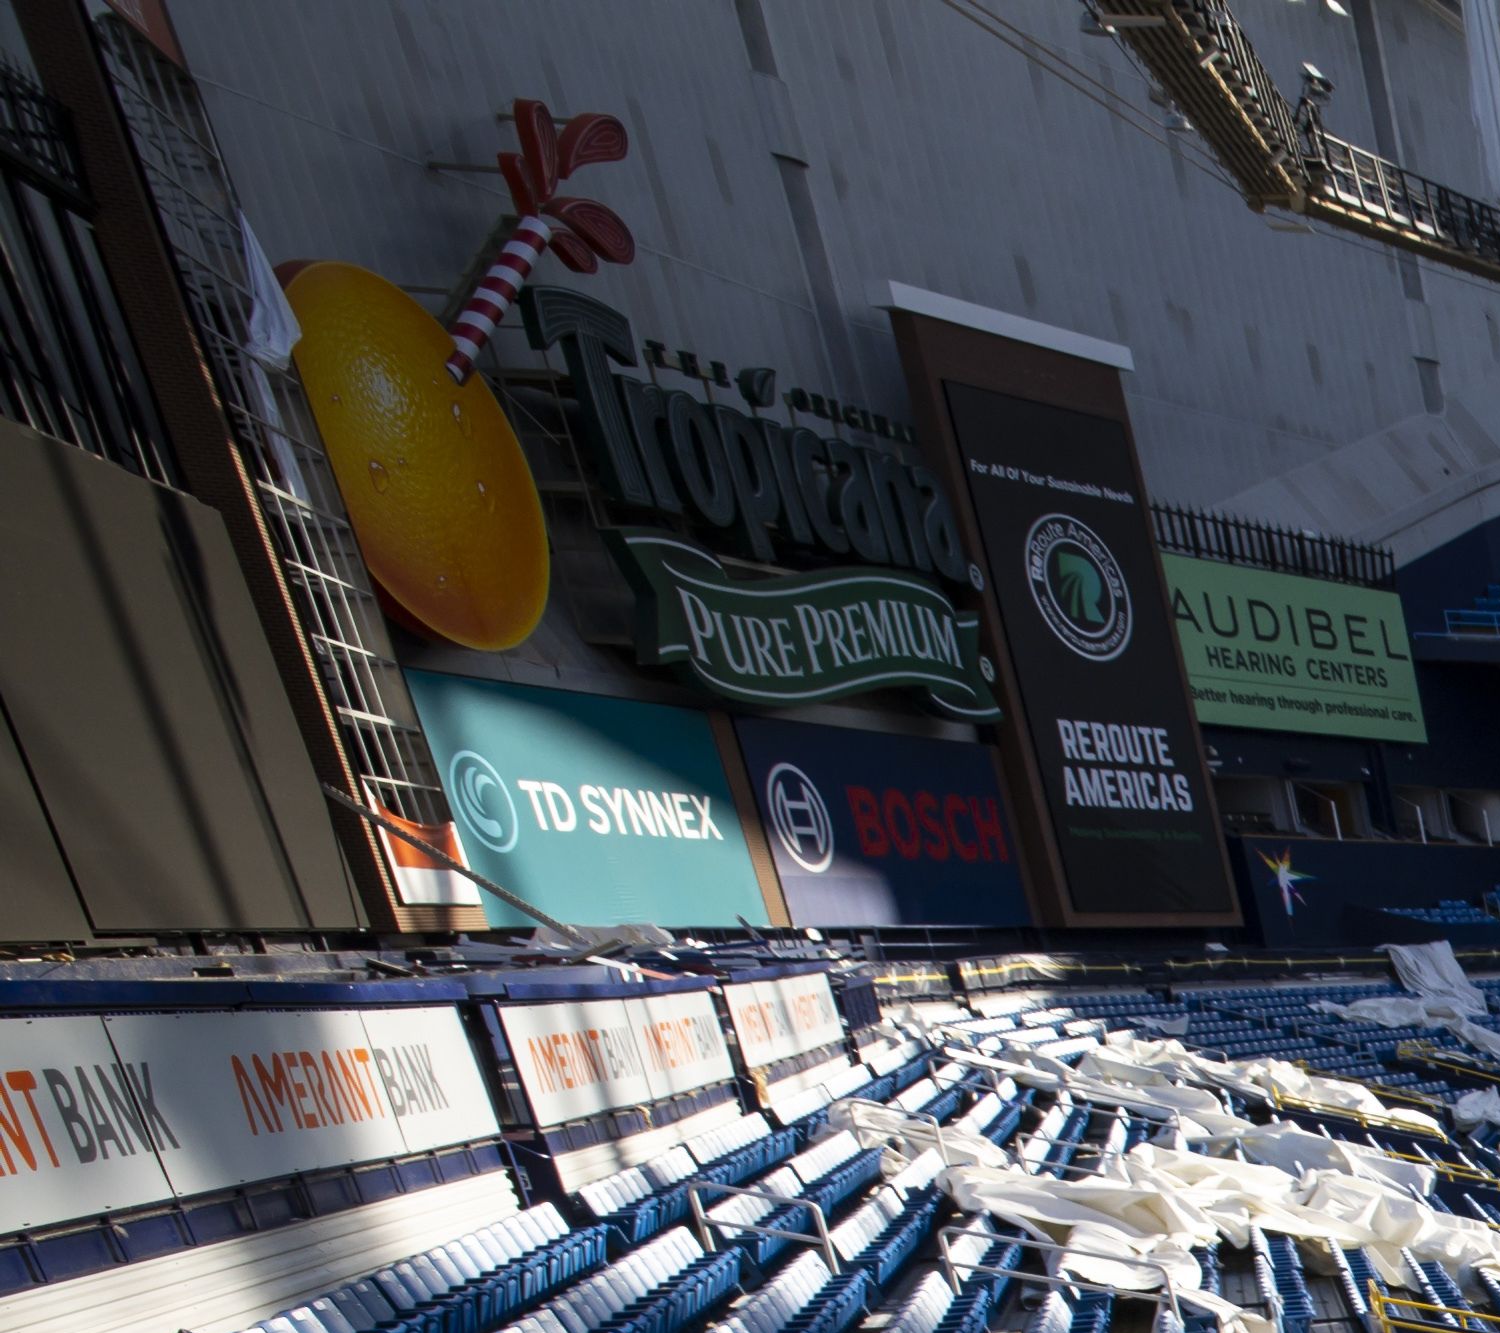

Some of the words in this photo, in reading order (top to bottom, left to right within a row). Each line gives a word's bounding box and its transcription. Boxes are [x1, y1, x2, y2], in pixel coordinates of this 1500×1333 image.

[522, 285, 970, 583] Tropicana
[970, 459, 988, 473] For
[991, 464, 1005, 478] All
[1021, 469, 1046, 486] Your
[675, 586, 805, 677] PURE
[799, 599, 966, 675] PREMIUM
[1173, 587, 1408, 661] AUDIBEL
[1205, 645, 1297, 678] HEARING
[1306, 658, 1388, 688] CENTERS
[1192, 684, 1227, 703] Better
[1230, 692, 1277, 711] hearing
[1278, 696, 1323, 714] through
[1325, 700, 1390, 719] professional
[1391, 710, 1418, 722] care.
[1056, 719, 1175, 767] REROUTE
[517, 780, 576, 832] TD
[579, 784, 723, 840] SYNNEX
[1063, 765, 1194, 812] AMERICAS
[851, 786, 1009, 863] BOSCH
[42, 1062, 181, 1164] BANK
[231, 1048, 386, 1136] AMERANT
[373, 1044, 451, 1118] BANK
